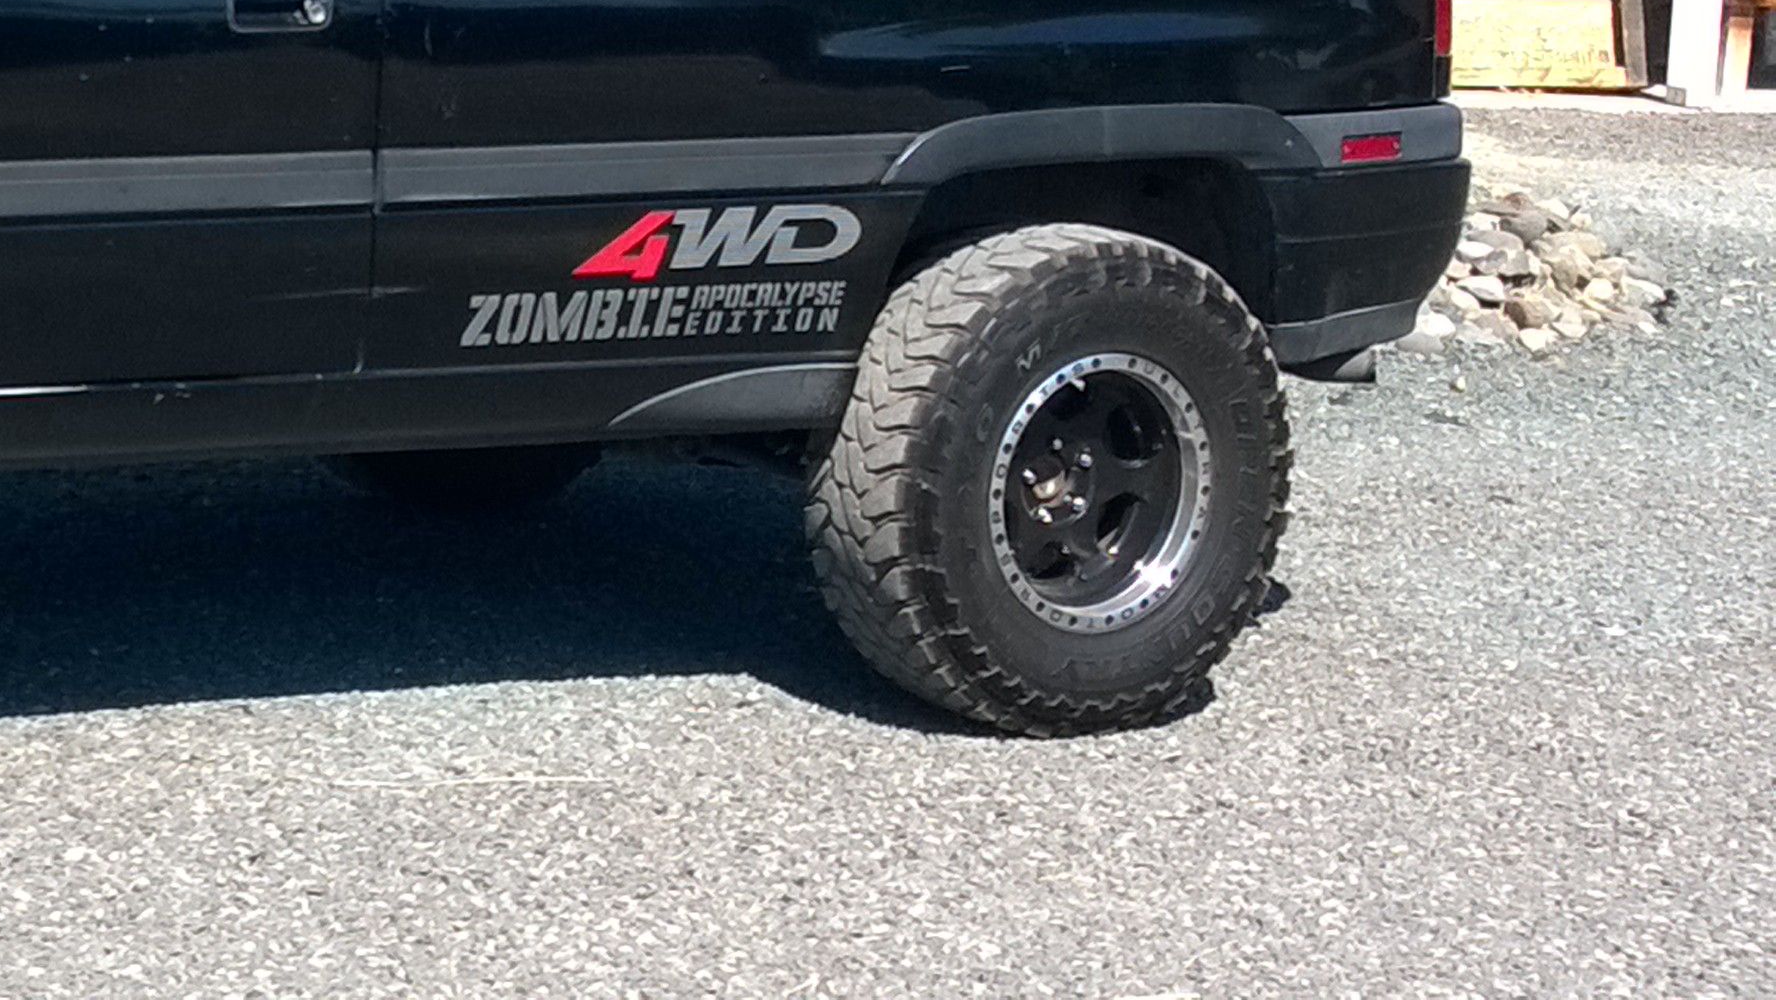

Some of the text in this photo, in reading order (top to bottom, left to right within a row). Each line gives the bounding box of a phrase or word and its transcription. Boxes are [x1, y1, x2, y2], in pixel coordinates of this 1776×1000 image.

[572, 204, 862, 281] 4WD
[460, 286, 690, 347] ZOMBIE
[691, 280, 846, 309] APOCALYPSE
[685, 306, 838, 335] EDITION
